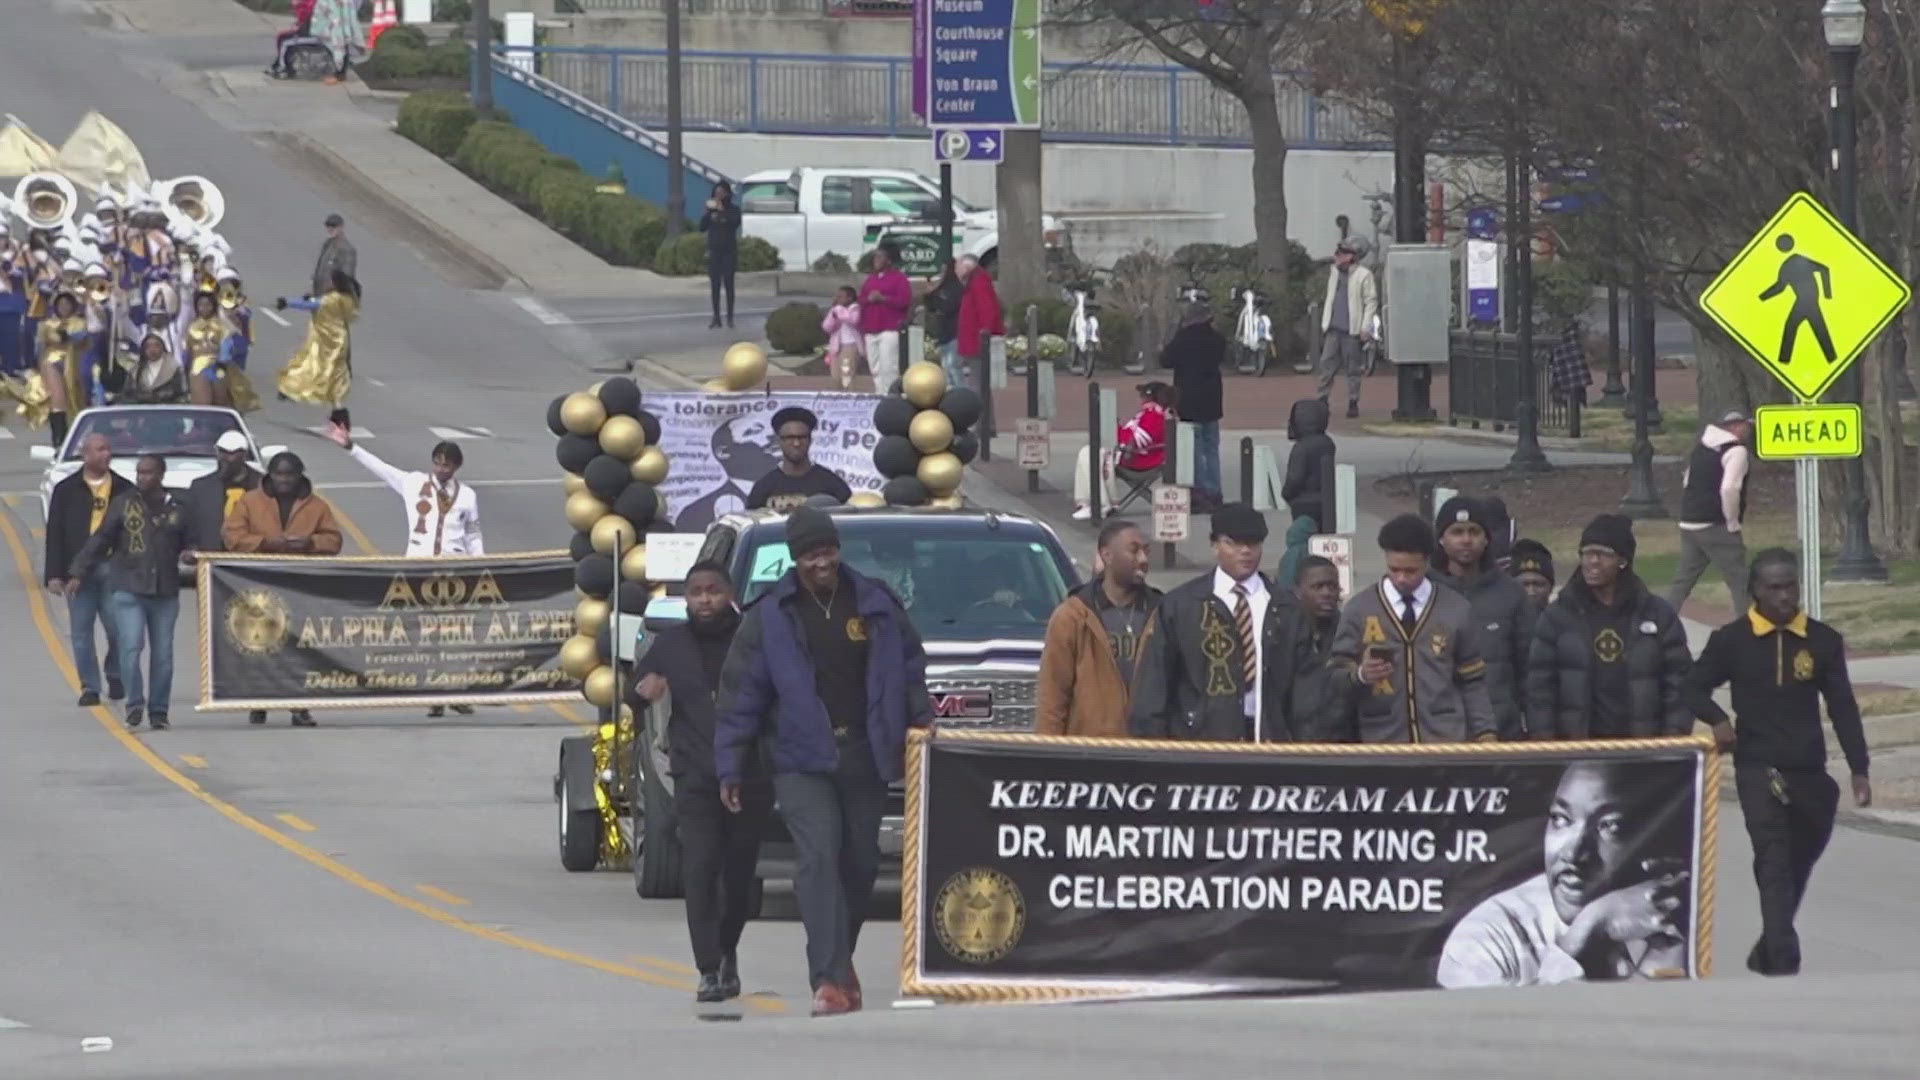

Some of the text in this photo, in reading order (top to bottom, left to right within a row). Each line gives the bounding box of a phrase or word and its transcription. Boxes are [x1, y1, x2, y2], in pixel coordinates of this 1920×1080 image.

[935, 0, 984, 12] Museum
[935, 26, 1004, 40] Courthouse
[936, 47, 978, 64] Square
[936, 77, 998, 91] Von Braun
[936, 97, 976, 113] Center
[946, 132, 965, 155] P
[674, 400, 778, 415] tolerance
[1772, 420, 1848, 443] AHEAD
[1163, 491, 1179, 501] NO
[1322, 540, 1339, 553] NO
[296, 615, 412, 649] ALPHA
[417, 612, 476, 647] PHI
[304, 669, 359, 689] Delta
[363, 668, 418, 689] Theta
[424, 667, 505, 689] Lambda
[989, 779, 1510, 815] KEEPING THE DREAM ALIVE
[997, 823, 1497, 863] DR. MARTIN LUTHER KING JR.
[1048, 874, 1444, 912] CELEBRATION PARADE
